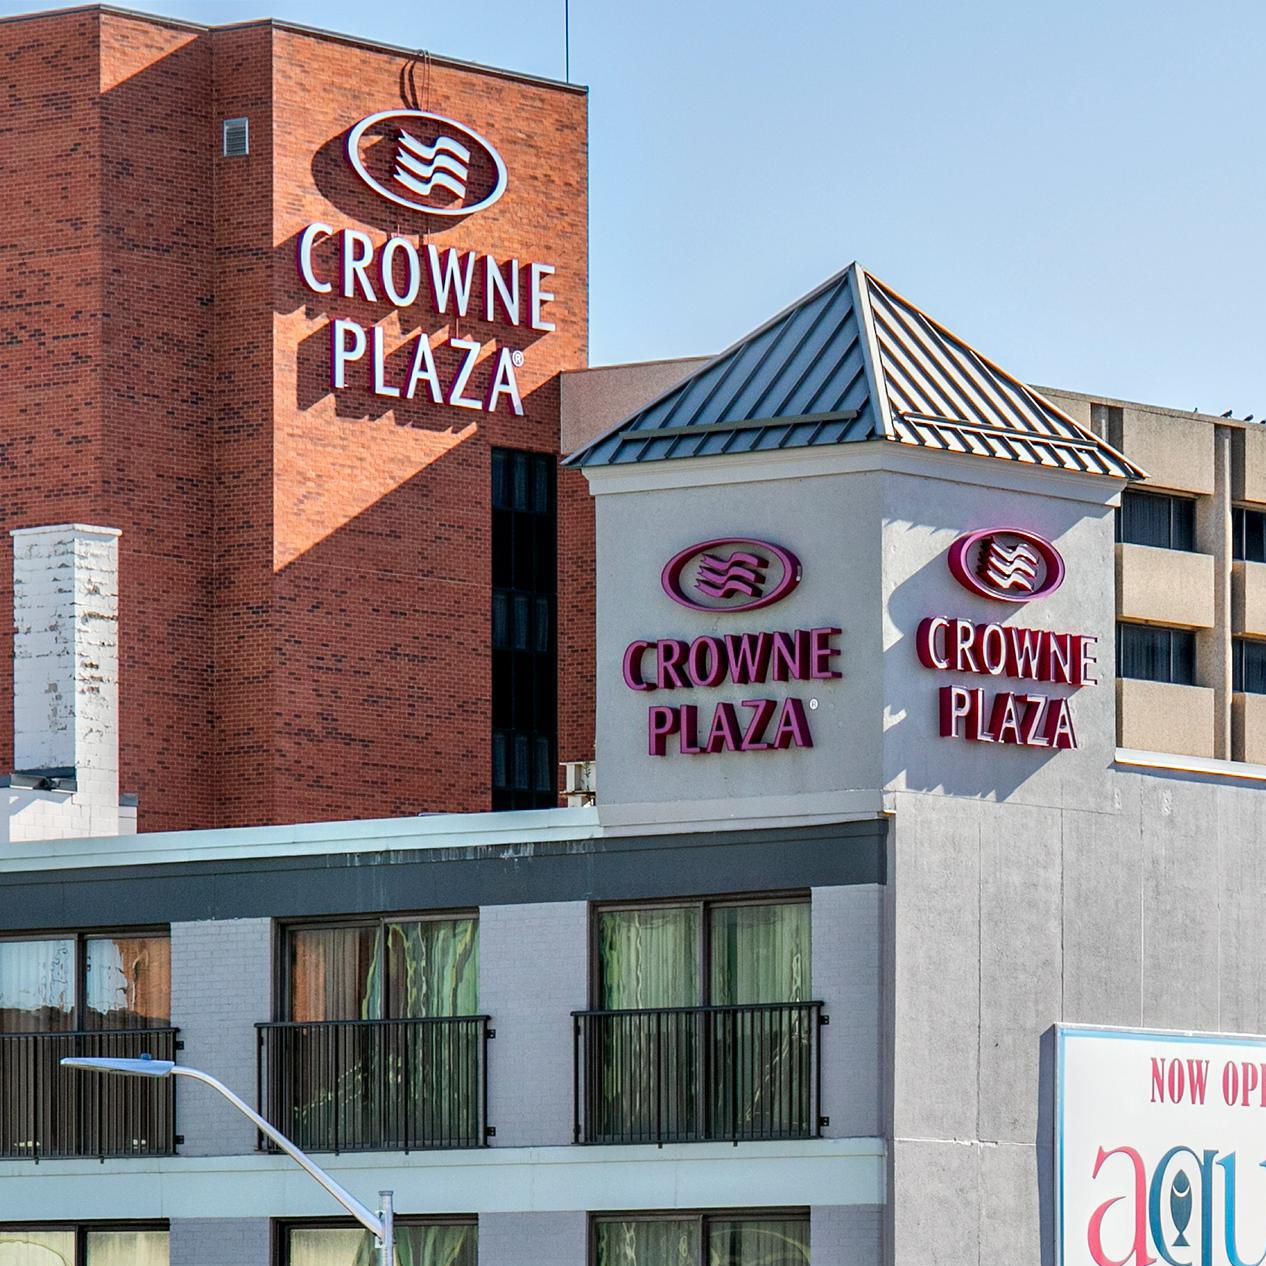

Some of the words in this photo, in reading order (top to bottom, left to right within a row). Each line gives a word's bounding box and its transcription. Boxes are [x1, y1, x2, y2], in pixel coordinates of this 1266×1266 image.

[298, 223, 556, 332] CROWNE
[332, 319, 525, 416] PLAZA
[622, 627, 843, 692] CROWNE
[916, 616, 1098, 687] CROWNE
[648, 697, 814, 757] PLAZA
[939, 685, 1078, 750] PLAZA
[1150, 1057, 1210, 1106] NOW
